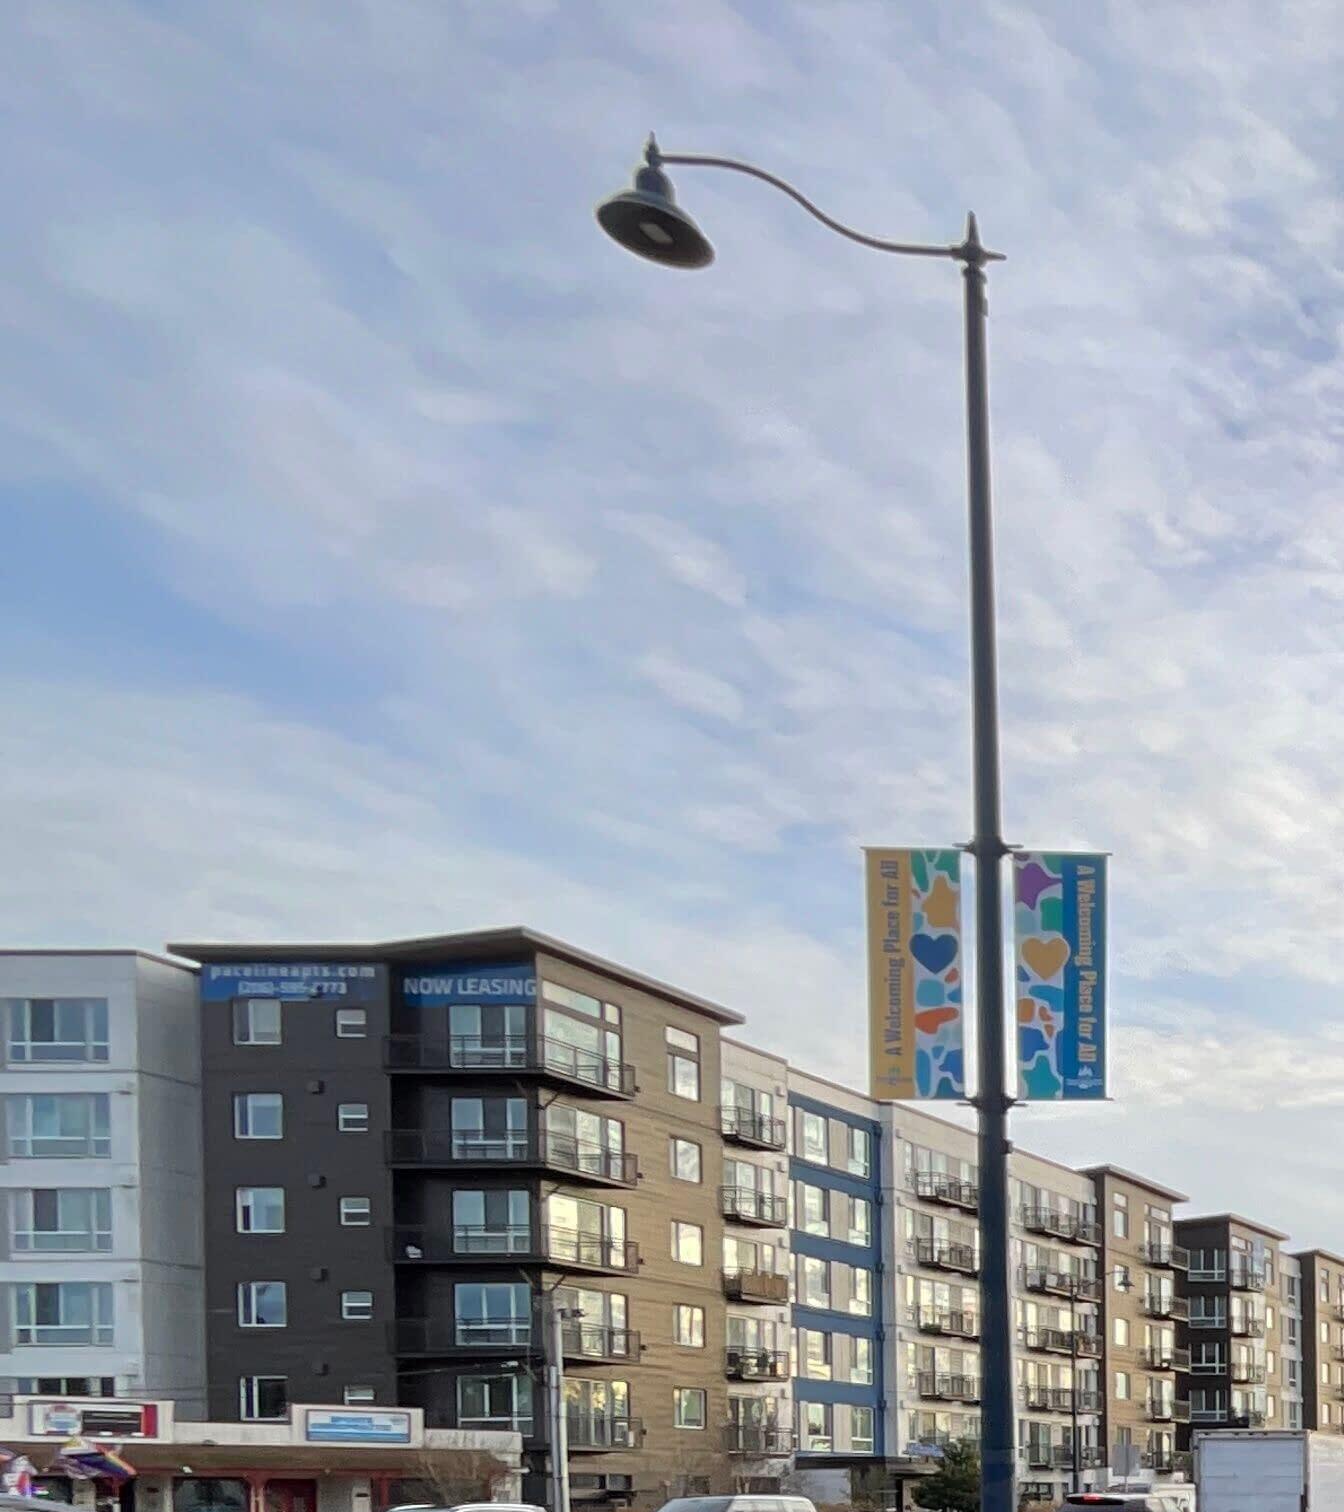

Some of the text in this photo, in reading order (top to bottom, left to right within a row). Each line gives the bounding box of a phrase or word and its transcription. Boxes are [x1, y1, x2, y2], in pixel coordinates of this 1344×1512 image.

[1076, 864, 1096, 875] A
[1074, 879, 1097, 967] Welcoming
[879, 859, 905, 1057] A Welcoming Place for All
[403, 977, 537, 996] NOW LEASING
[1078, 969, 1098, 1013] Place
[1078, 1016, 1098, 1040] for
[1078, 1042, 1098, 1063] All
